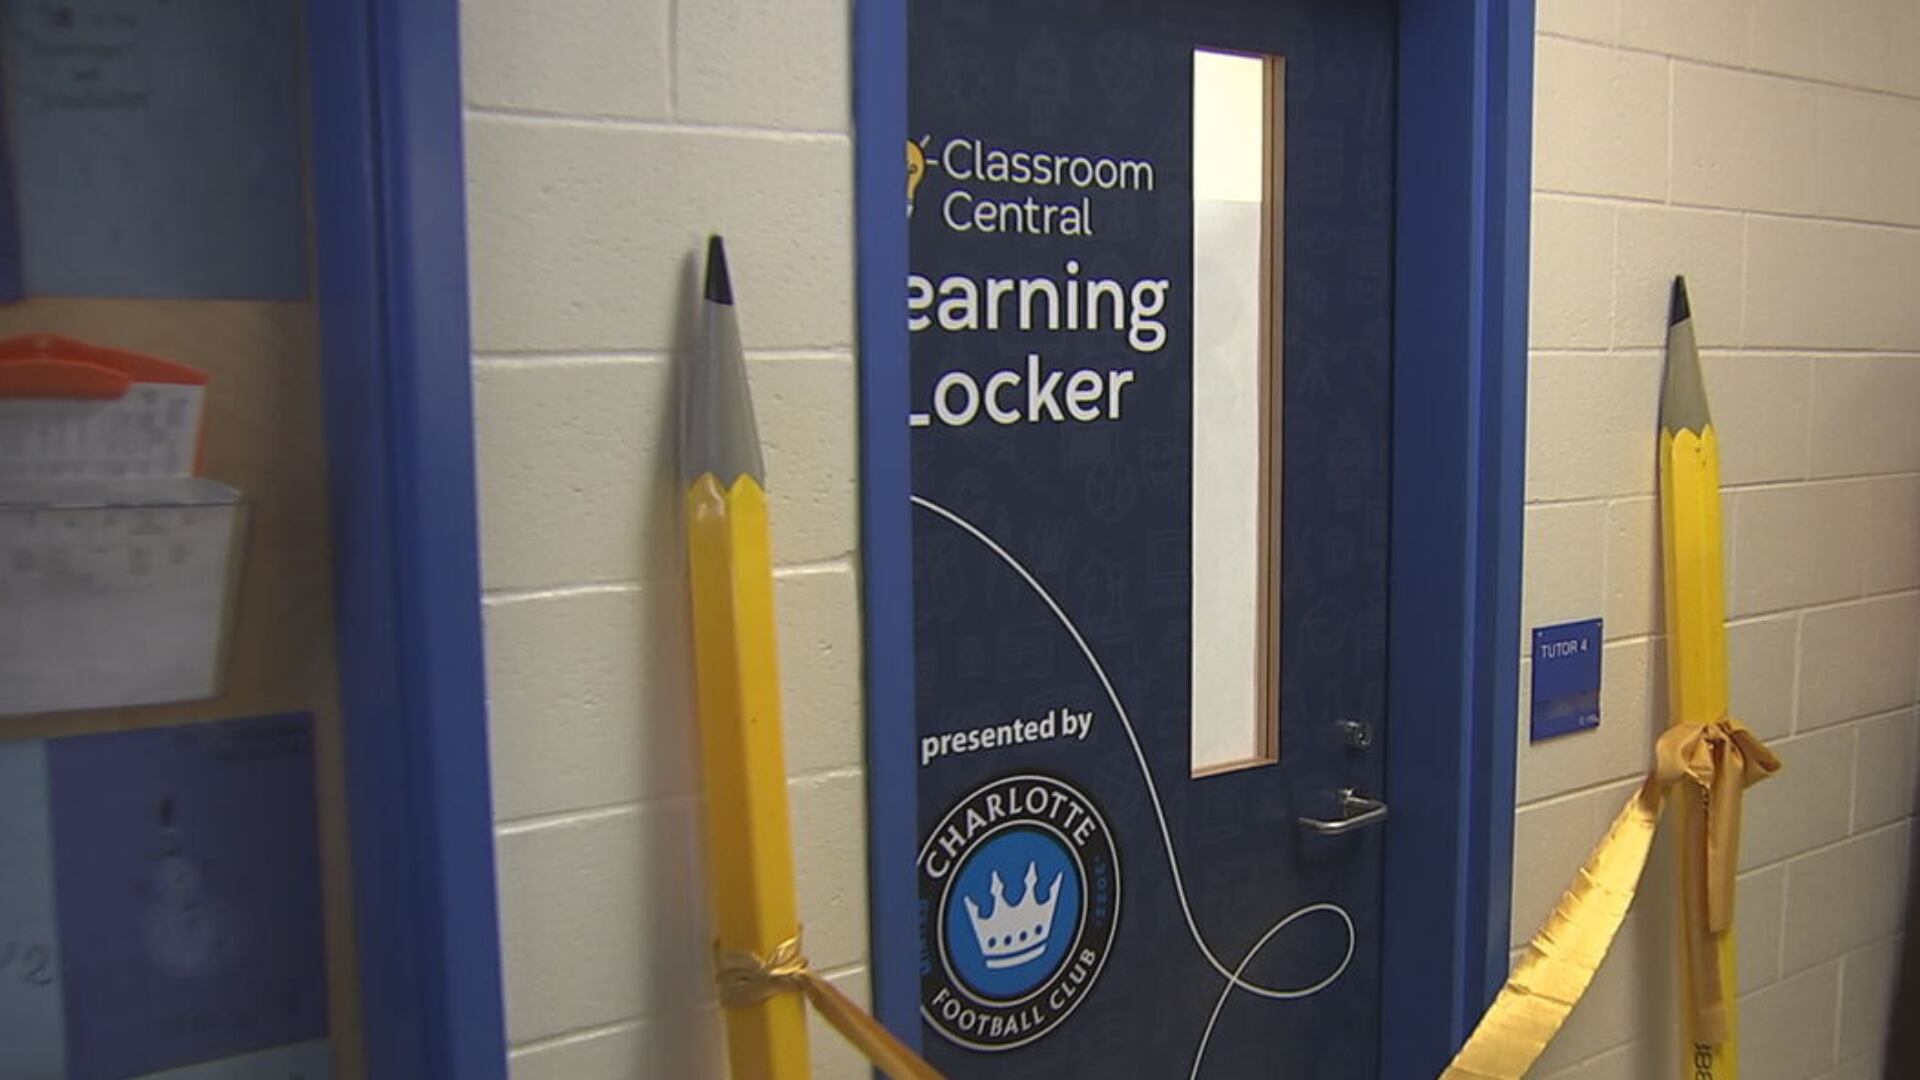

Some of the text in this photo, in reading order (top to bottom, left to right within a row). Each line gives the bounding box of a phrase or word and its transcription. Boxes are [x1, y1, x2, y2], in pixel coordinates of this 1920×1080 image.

[942, 138, 1154, 190] Classroom
[942, 190, 1093, 236] Central
[907, 260, 1170, 352] earning
[1541, 639, 1588, 658] TUTOR 4
[921, 708, 1093, 765] presented by
[925, 785, 1097, 879] CHARLOTTE
[932, 948, 1096, 1037] FOOTBALL CLUB
